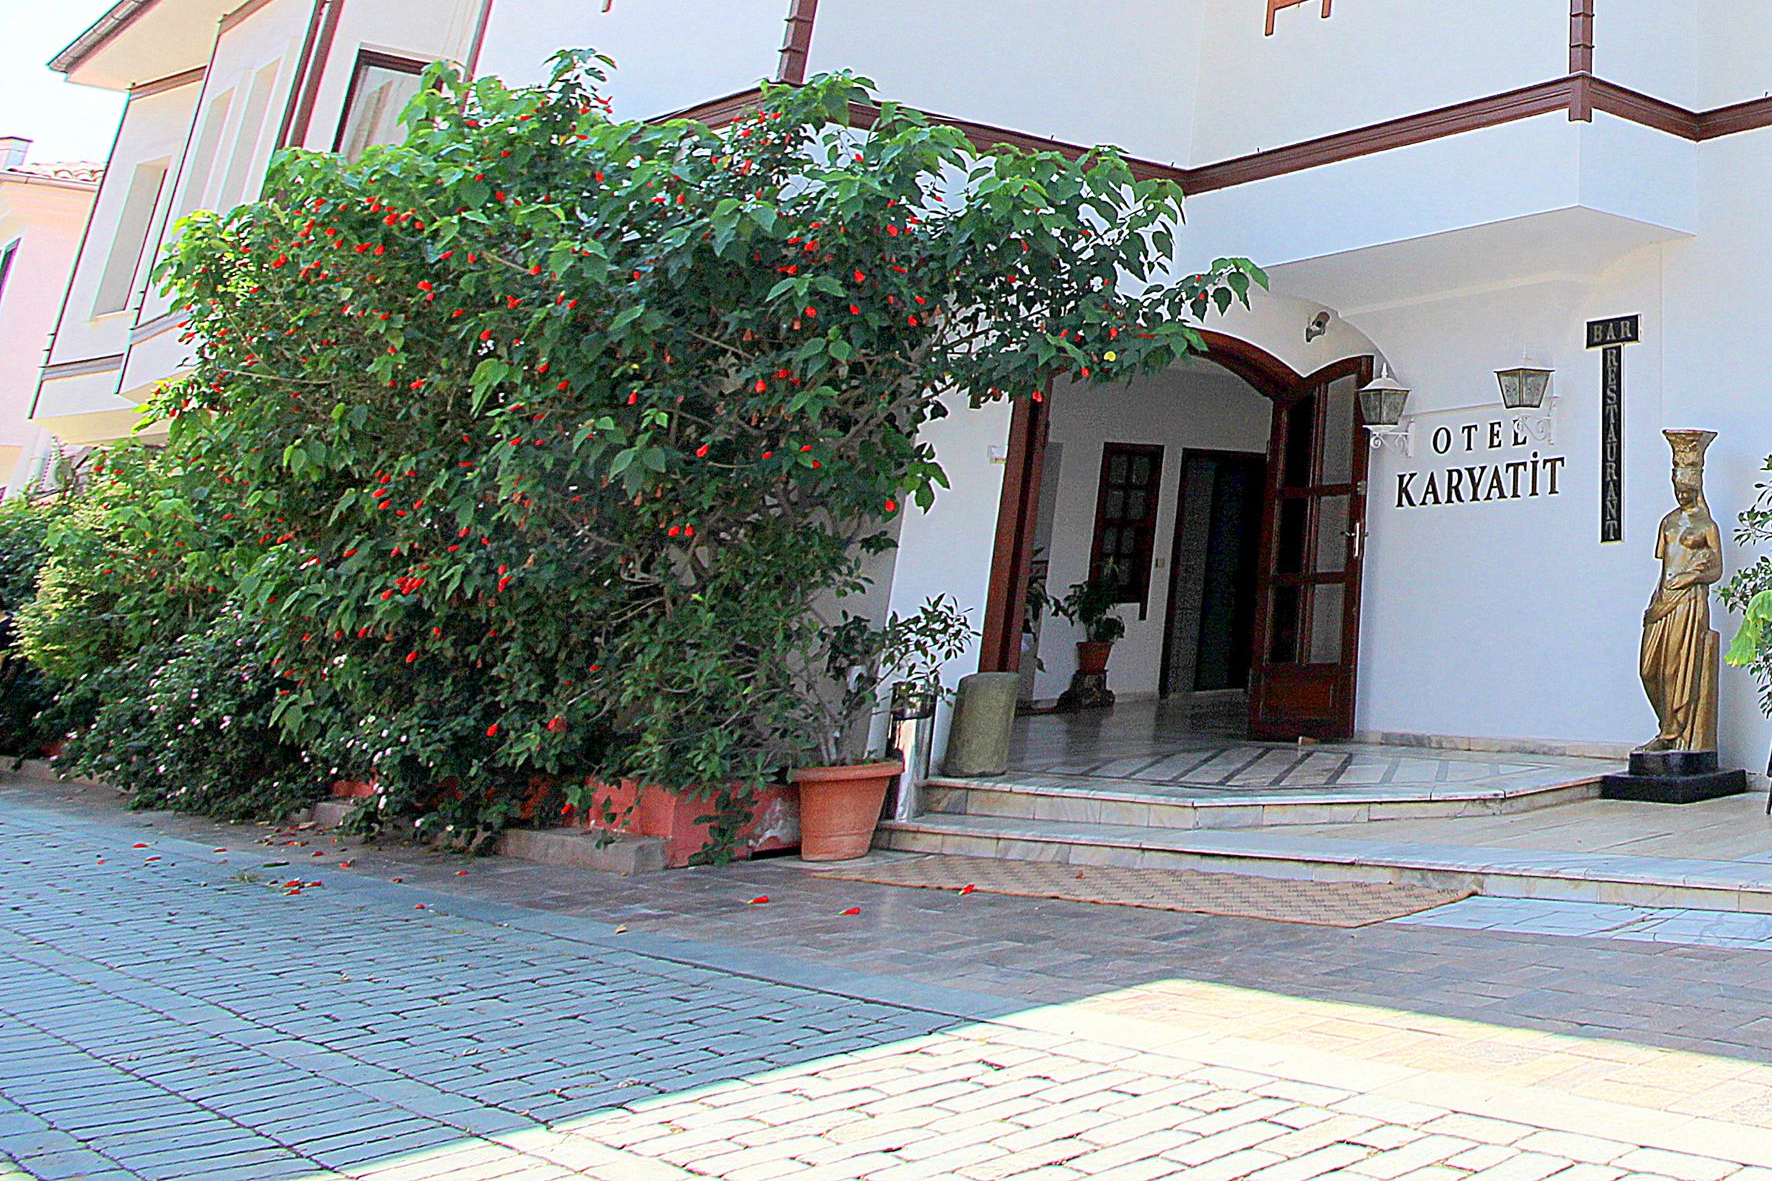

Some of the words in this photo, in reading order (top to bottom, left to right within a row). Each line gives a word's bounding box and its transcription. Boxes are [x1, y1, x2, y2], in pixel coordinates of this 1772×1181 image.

[1592, 320, 1632, 343] BAR
[1431, 418, 1528, 455] OTEL
[1605, 348, 1619, 541] RESTAURANT
[1395, 451, 1565, 507] KARYATİT
